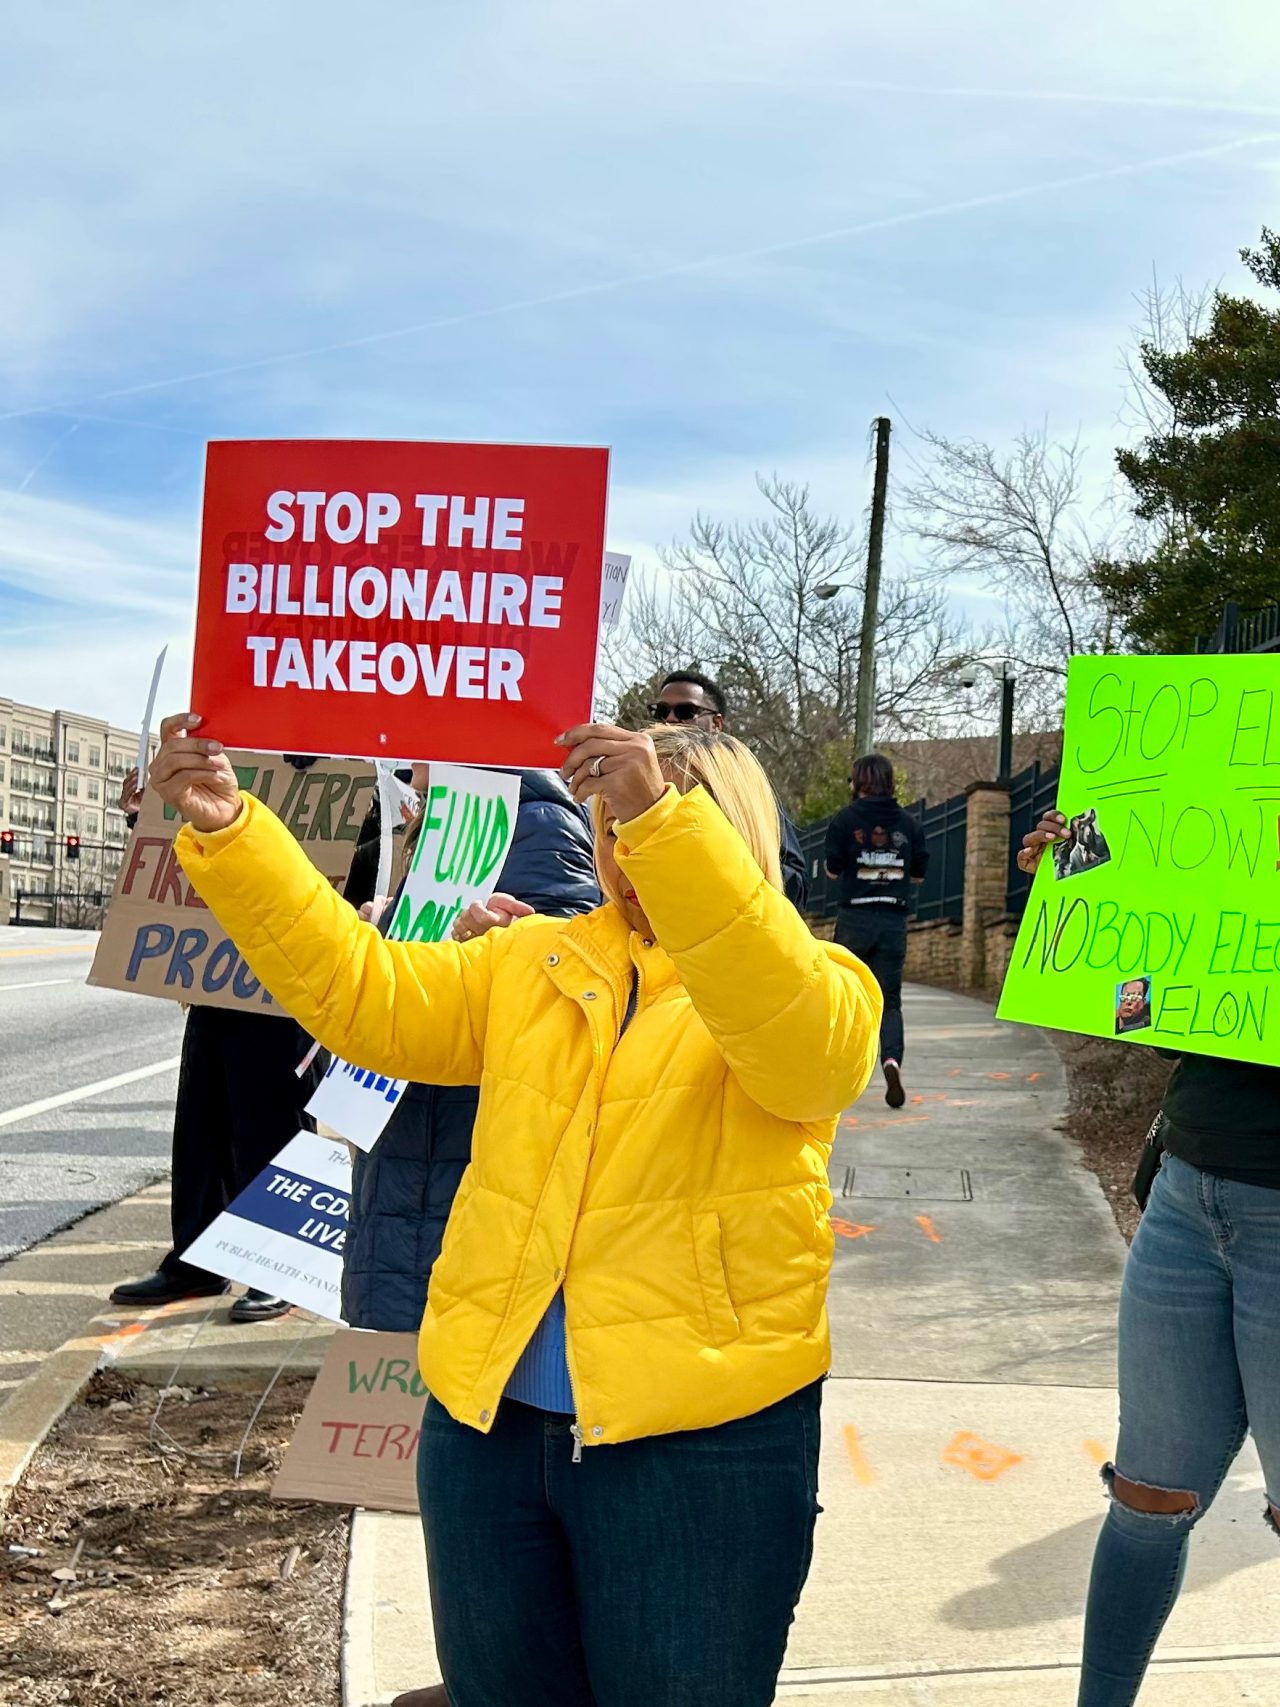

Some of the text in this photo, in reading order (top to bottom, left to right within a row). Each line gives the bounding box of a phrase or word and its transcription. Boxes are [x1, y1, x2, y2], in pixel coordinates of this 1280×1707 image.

[263, 490, 525, 551] STOP THE
[225, 563, 564, 629] BILLIONAIRE
[604, 563, 628, 583] TION
[246, 637, 526, 702] TAKEOVER
[413, 786, 509, 887] FUND
[126, 923, 273, 1004] PROO
[1022, 897, 1195, 975] NOBODY
[266, 1173, 312, 1203] THE
[328, 1150, 353, 1168] THA
[298, 1218, 347, 1250] LIVE
[215, 1240, 340, 1297] PUBLIC HEALTH STAND
[349, 1357, 430, 1397] WRO
